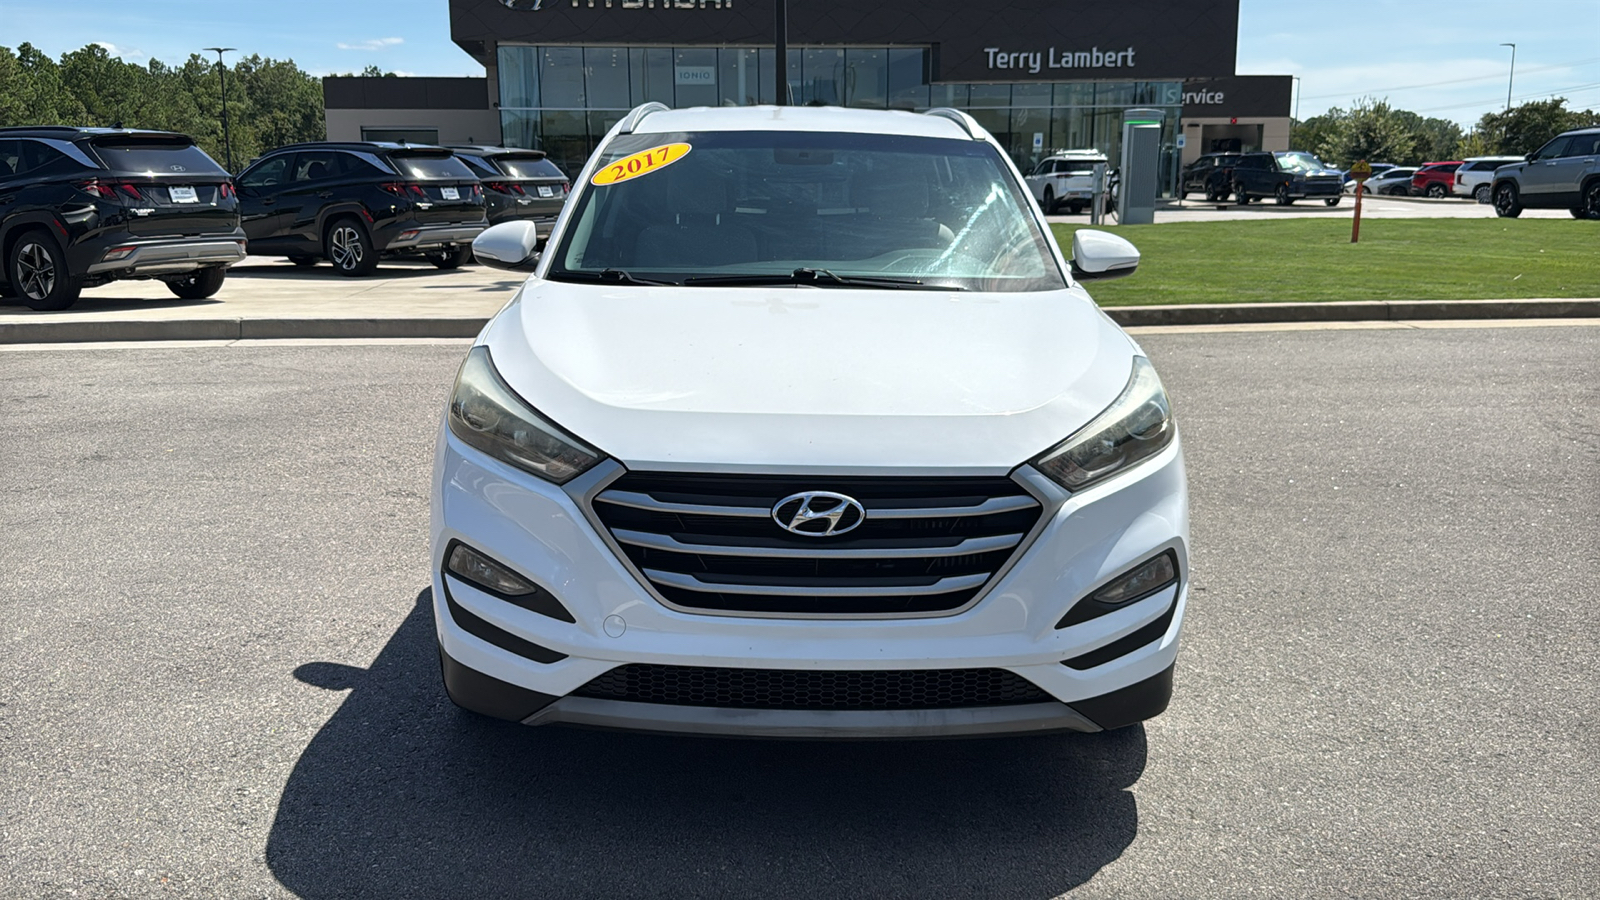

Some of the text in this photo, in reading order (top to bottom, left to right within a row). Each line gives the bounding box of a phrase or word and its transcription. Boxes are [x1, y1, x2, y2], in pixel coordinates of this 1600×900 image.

[983, 46, 1135, 74] Terry Lambert
[611, 146, 669, 181] 2017
